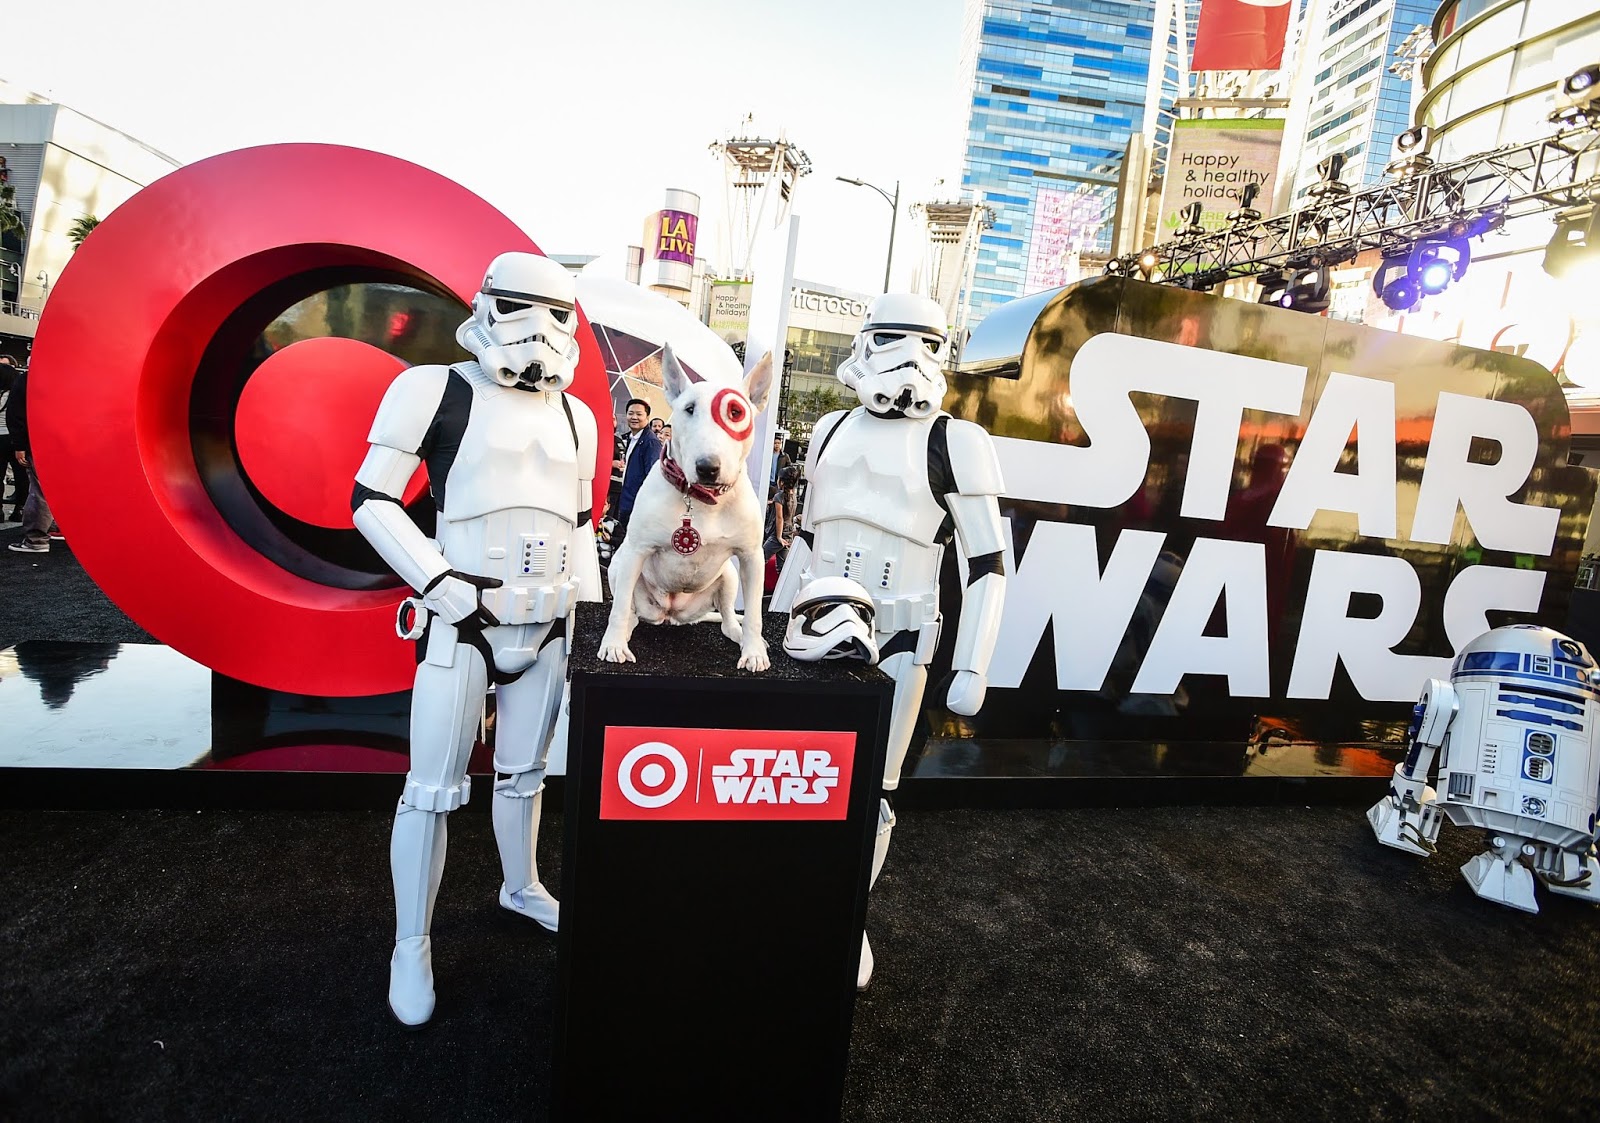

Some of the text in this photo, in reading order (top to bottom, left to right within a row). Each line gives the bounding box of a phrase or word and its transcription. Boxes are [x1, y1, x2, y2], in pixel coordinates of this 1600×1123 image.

[1181, 152, 1240, 169] Happy
[1185, 168, 1270, 186] & healthy
[1183, 184, 1239, 199] holida
[661, 216, 689, 241] LA
[660, 237, 694, 256] LIVE
[715, 294, 739, 302] Happy
[725, 302, 751, 311] healthy
[791, 287, 868, 318] icroso
[715, 308, 748, 318] holidays!
[989, 331, 1562, 557] STAR
[954, 516, 1547, 702] WARS
[711, 748, 840, 777] STAR
[711, 776, 838, 804] WARS
